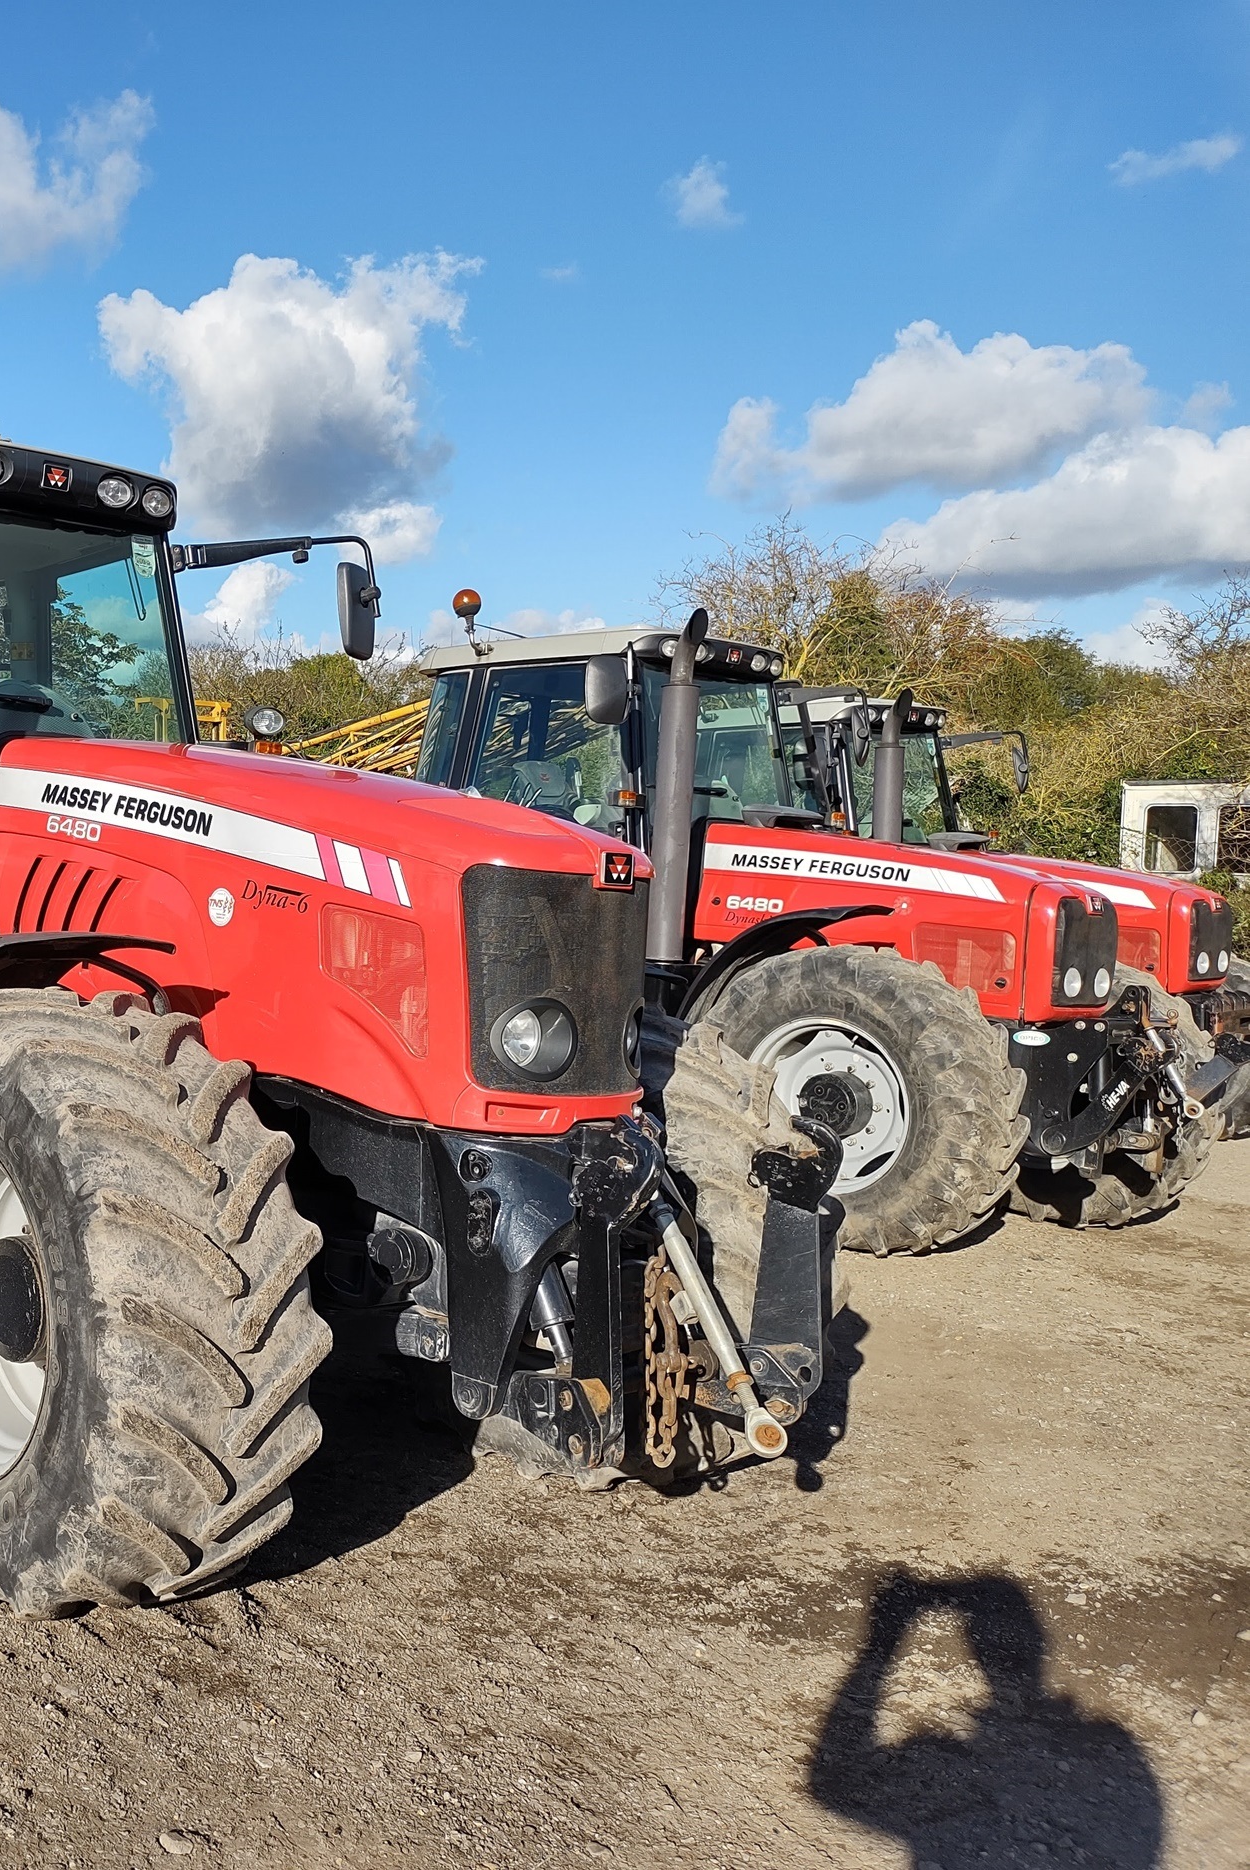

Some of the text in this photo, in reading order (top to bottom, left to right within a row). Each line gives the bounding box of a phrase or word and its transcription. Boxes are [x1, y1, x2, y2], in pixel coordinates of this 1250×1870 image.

[41, 783, 213, 837] MASSEY FERGUSON
[46, 815, 102, 842] 6480
[731, 854, 911, 882] MASSEY FERGUSON
[241, 880, 312, 914] Dyna-6
[726, 895, 784, 913] 6480
[1106, 1080, 1131, 1109] HE-VA
